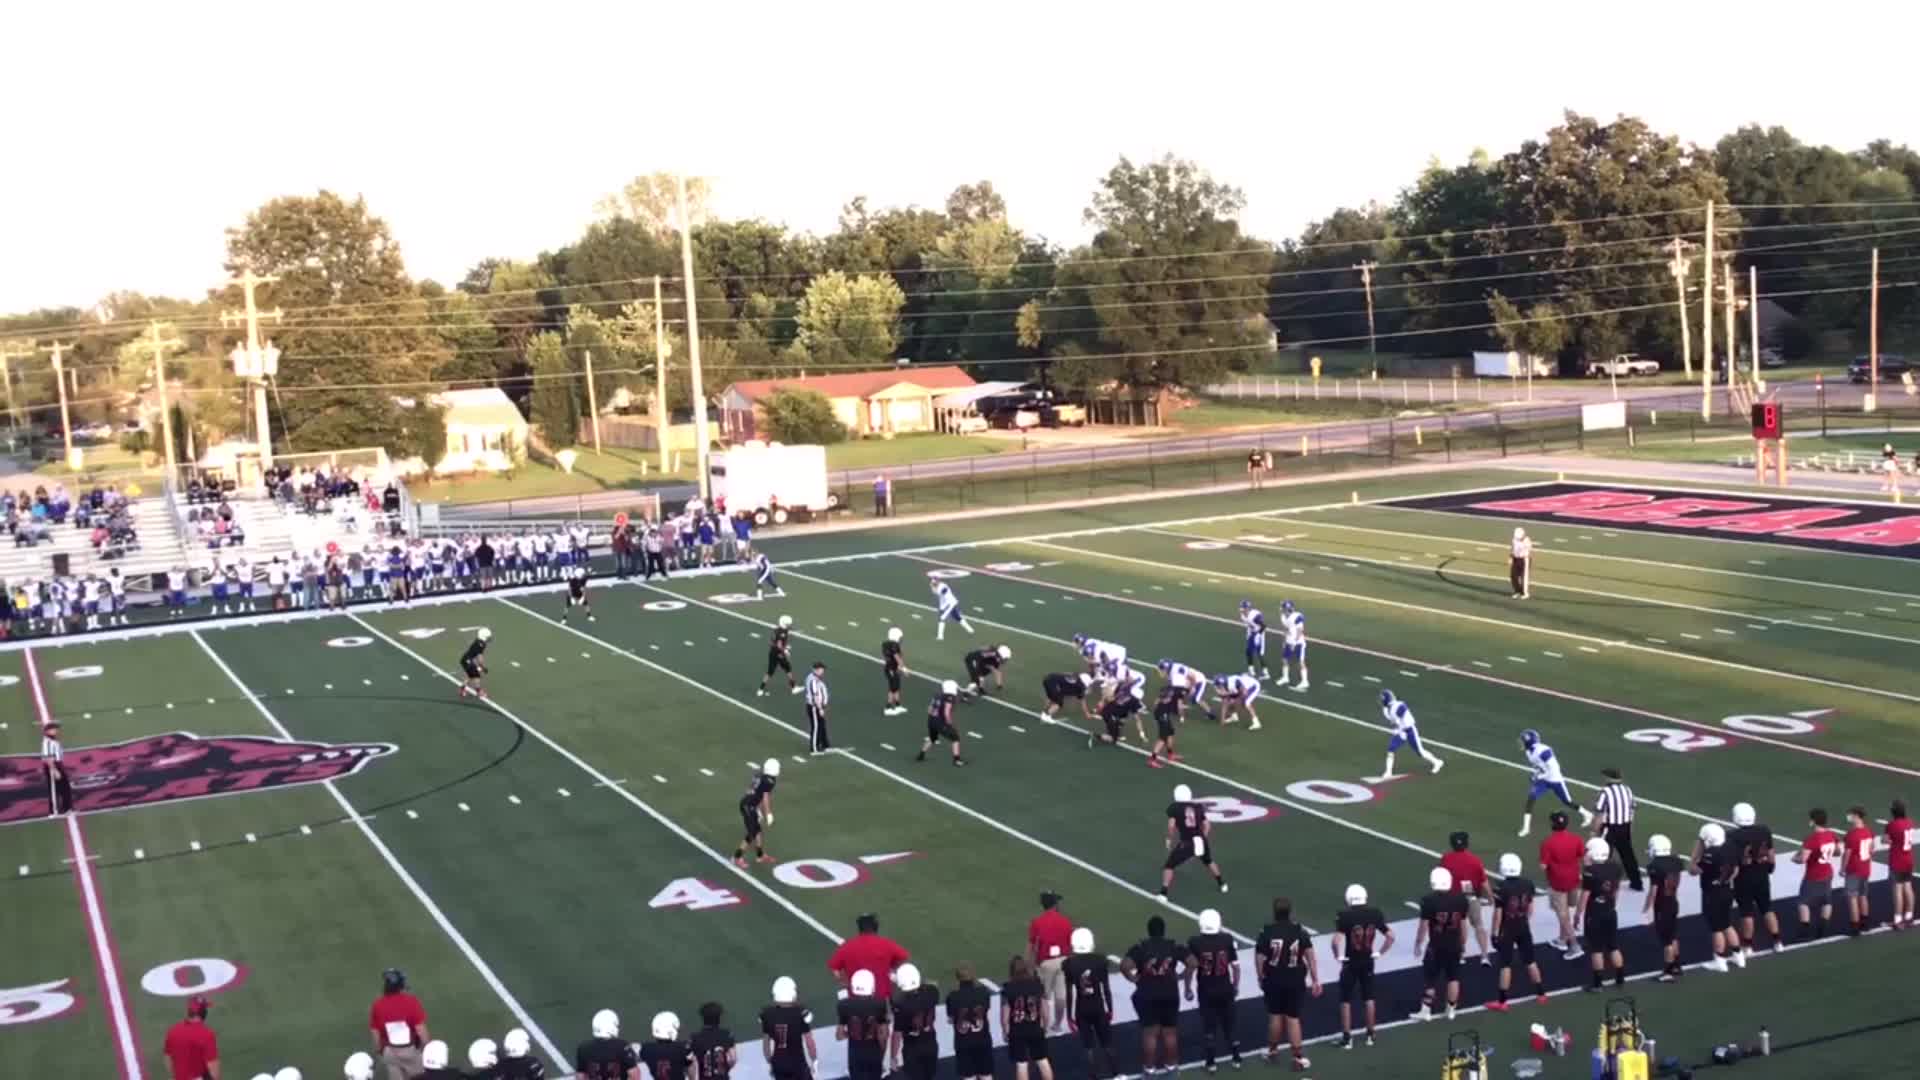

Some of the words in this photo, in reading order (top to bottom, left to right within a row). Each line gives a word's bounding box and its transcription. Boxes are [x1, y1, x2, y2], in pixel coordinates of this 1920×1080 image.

[1623, 714, 1815, 753] 20
[1190, 779, 1374, 823] 30
[648, 858, 859, 911] 40
[1269, 938, 1299, 967] 71
[0, 958, 237, 1025] 50
